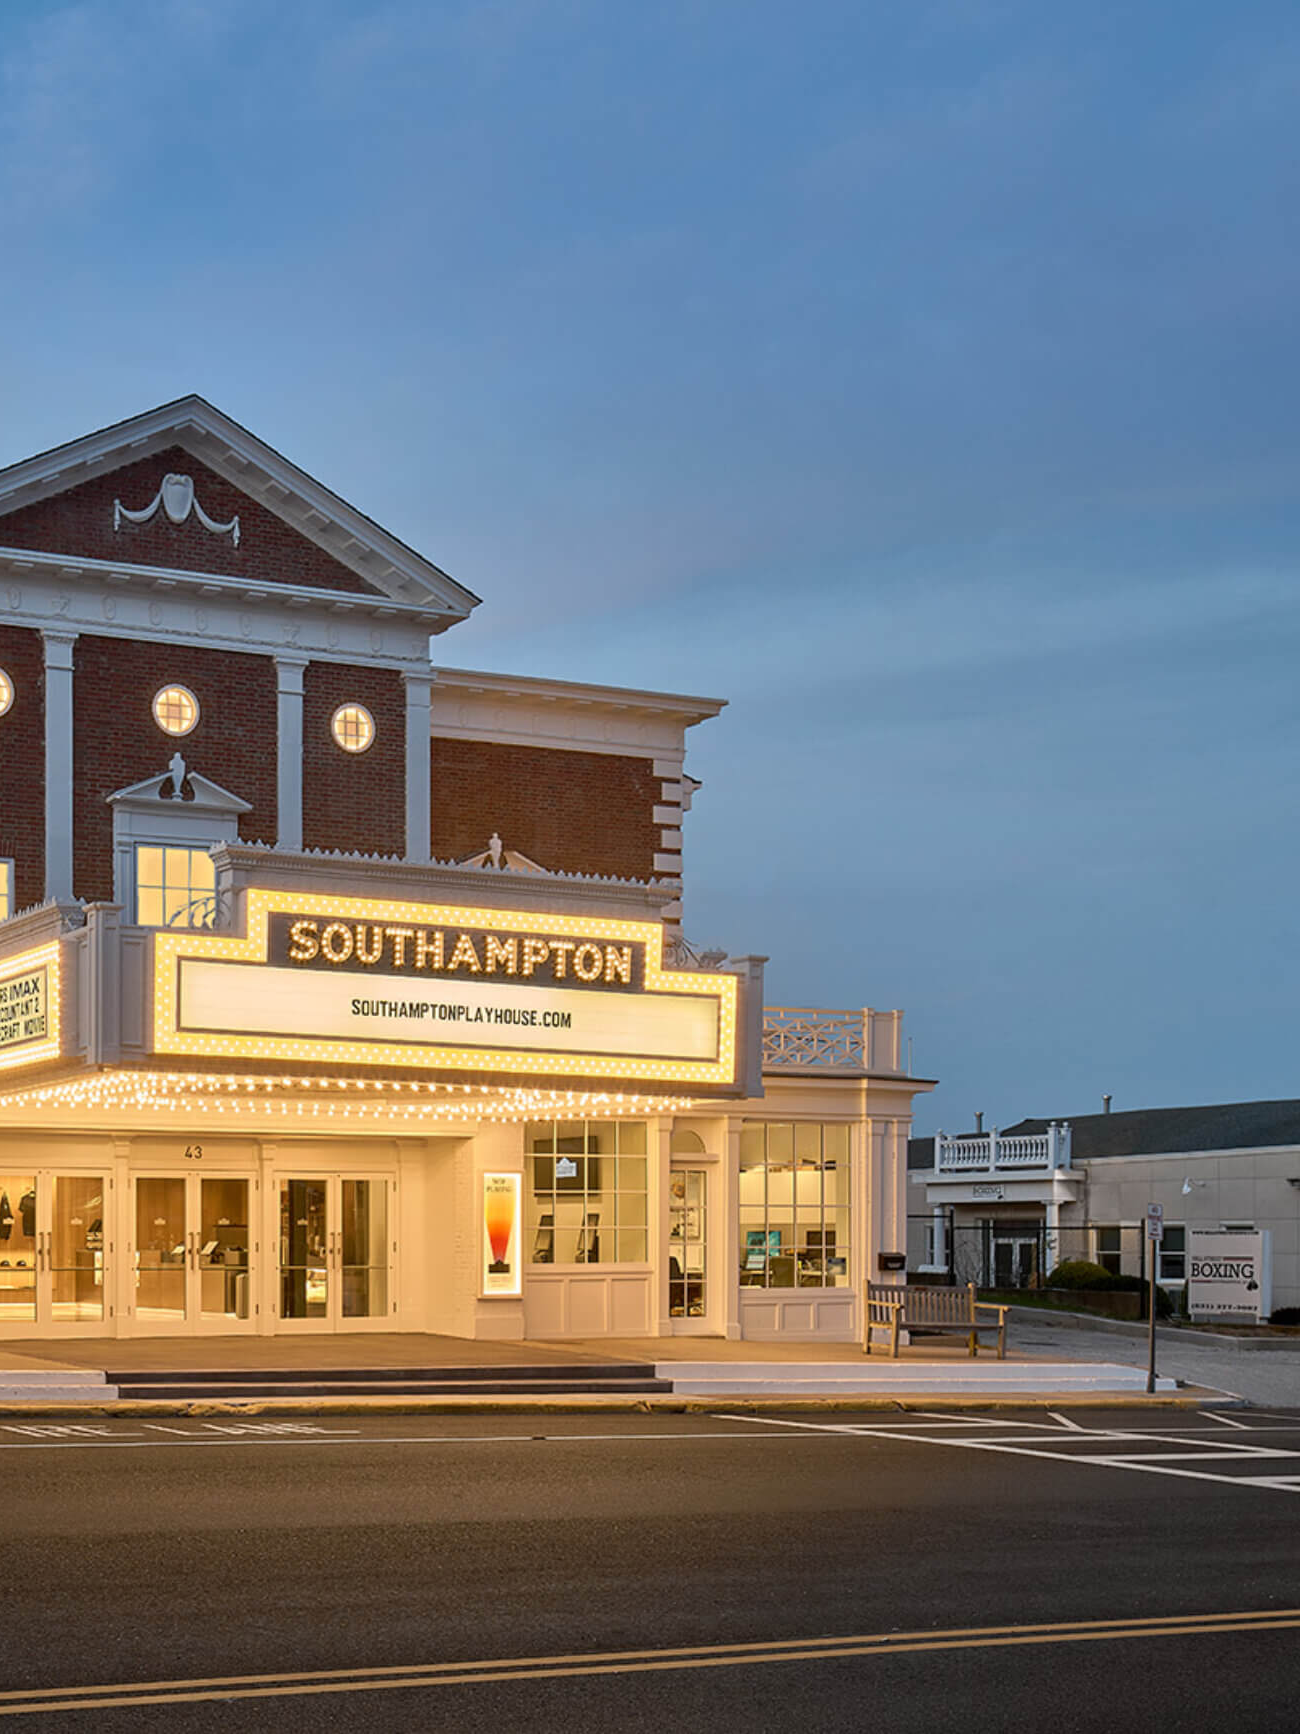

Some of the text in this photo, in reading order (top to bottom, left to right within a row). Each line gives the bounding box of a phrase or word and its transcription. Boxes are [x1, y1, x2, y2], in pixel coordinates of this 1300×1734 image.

[288, 920, 632, 984] SOUTHAMPTON
[9, 977, 40, 1001] IMAX
[351, 998, 572, 1029] SOUTHAMPTONPLAYHOUSE.COM
[184, 1145, 203, 1159] 43
[1191, 1262, 1254, 1279] BOXING
[141, 1422, 361, 1436] LANE
